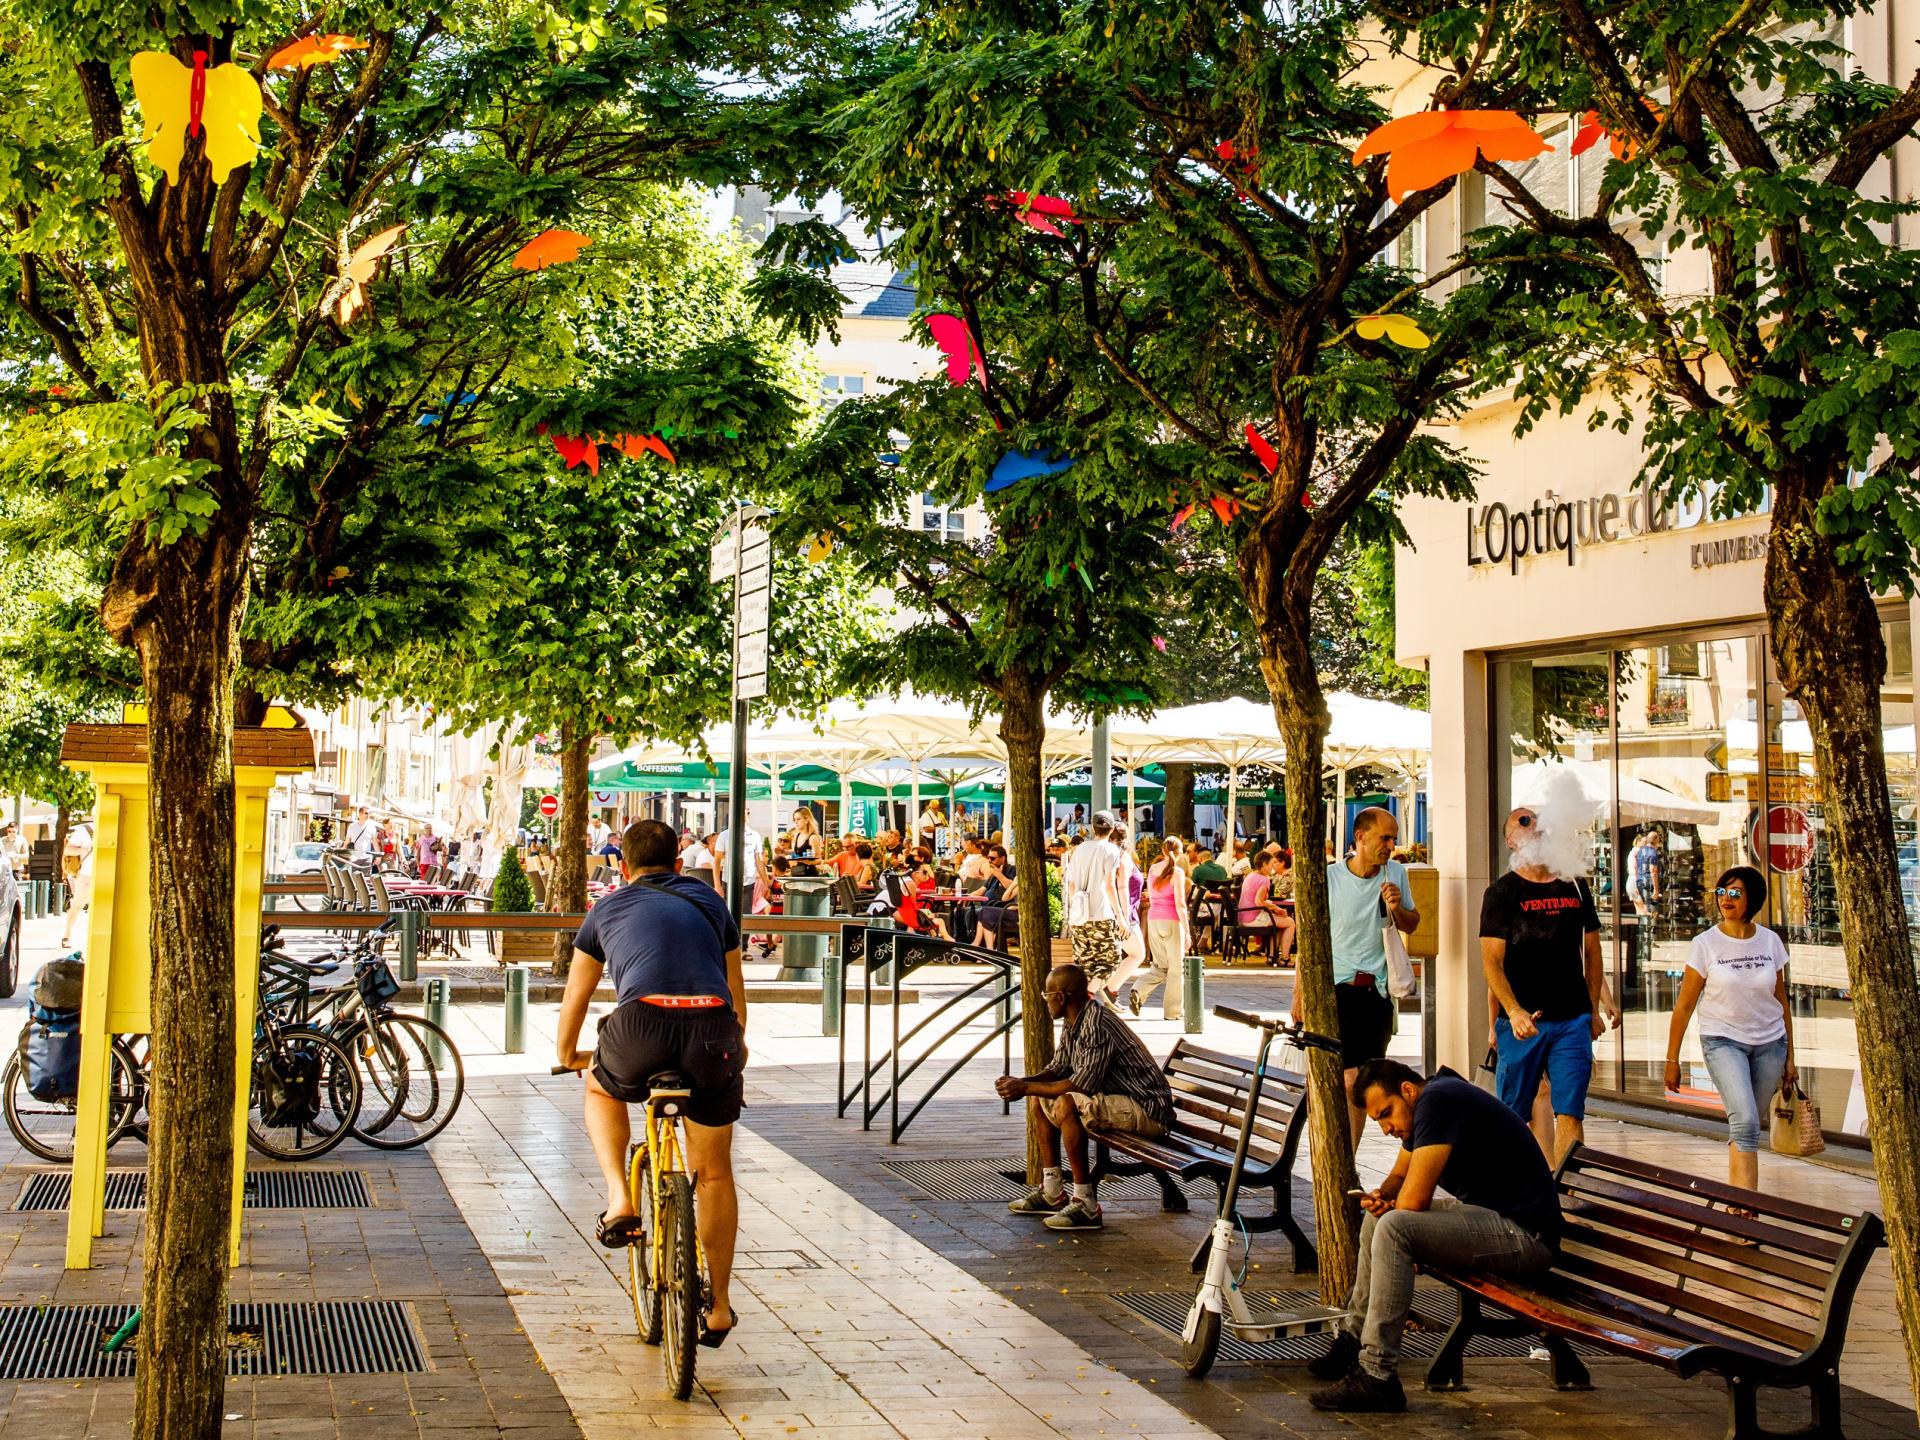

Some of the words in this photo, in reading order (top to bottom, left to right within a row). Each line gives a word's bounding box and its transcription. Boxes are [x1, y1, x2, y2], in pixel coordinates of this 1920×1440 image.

[1467, 493, 1620, 576] L'Optique
[1627, 475, 1669, 537] du
[636, 764, 684, 773] BOFFERDING
[1235, 790, 1267, 798] OFFERDING
